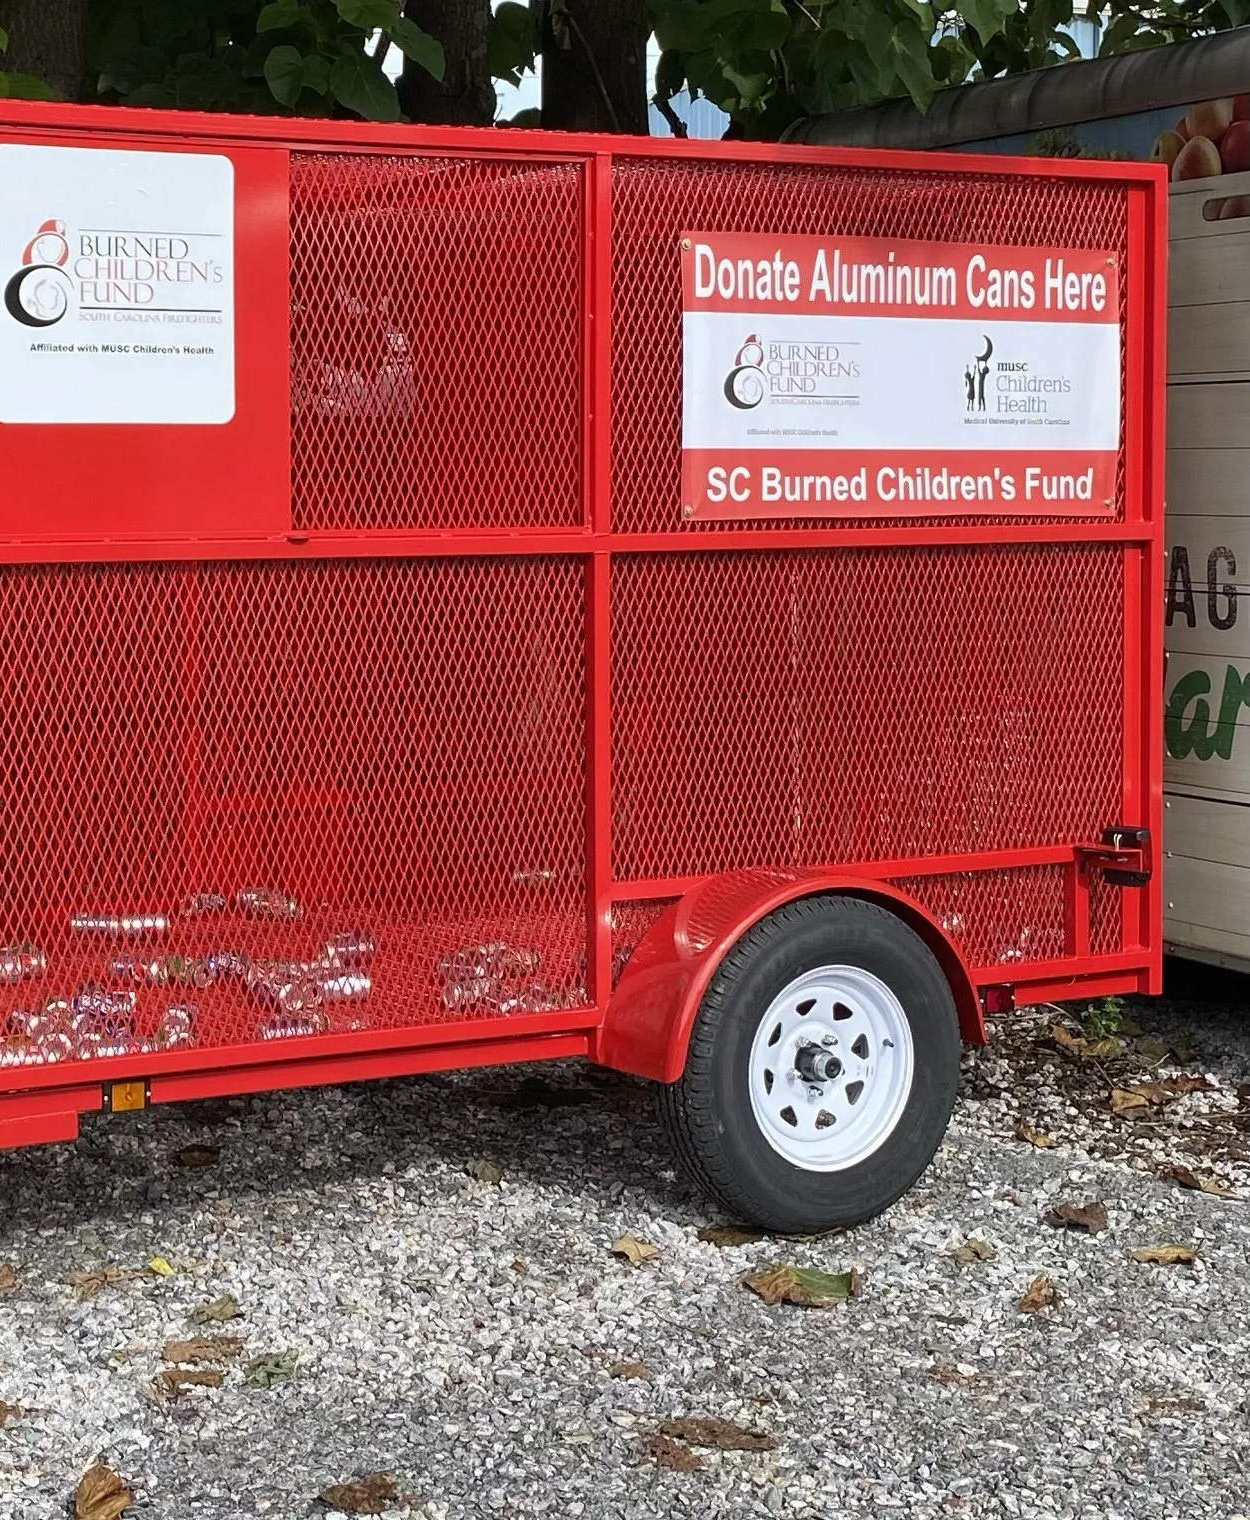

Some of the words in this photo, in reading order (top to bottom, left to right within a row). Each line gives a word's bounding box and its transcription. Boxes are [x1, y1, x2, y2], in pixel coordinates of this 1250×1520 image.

[80, 235, 189, 259] BURNED
[695, 244, 800, 301] Donate
[809, 249, 956, 306] Aluminum
[966, 254, 1035, 309] Cans
[1045, 258, 1106, 311] Here
[80, 281, 154, 304] FUND
[78, 311, 111, 322] SOUTH
[113, 312, 160, 323] CAROLINA
[30, 343, 75, 353] Affiliated
[77, 344, 99, 353] with
[101, 345, 130, 353] MUSC
[133, 345, 180, 355] Children's
[183, 346, 214, 355] Health
[769, 344, 839, 361] BURNED
[997, 362, 1028, 372] musc
[770, 377, 816, 392] FUND
[996, 374, 1071, 393] Children's
[997, 395, 1047, 413] Health
[707, 466, 751, 502] SC
[761, 467, 867, 502] Burned
[876, 466, 1016, 501] Children's
[1025, 467, 1094, 501] Fund
